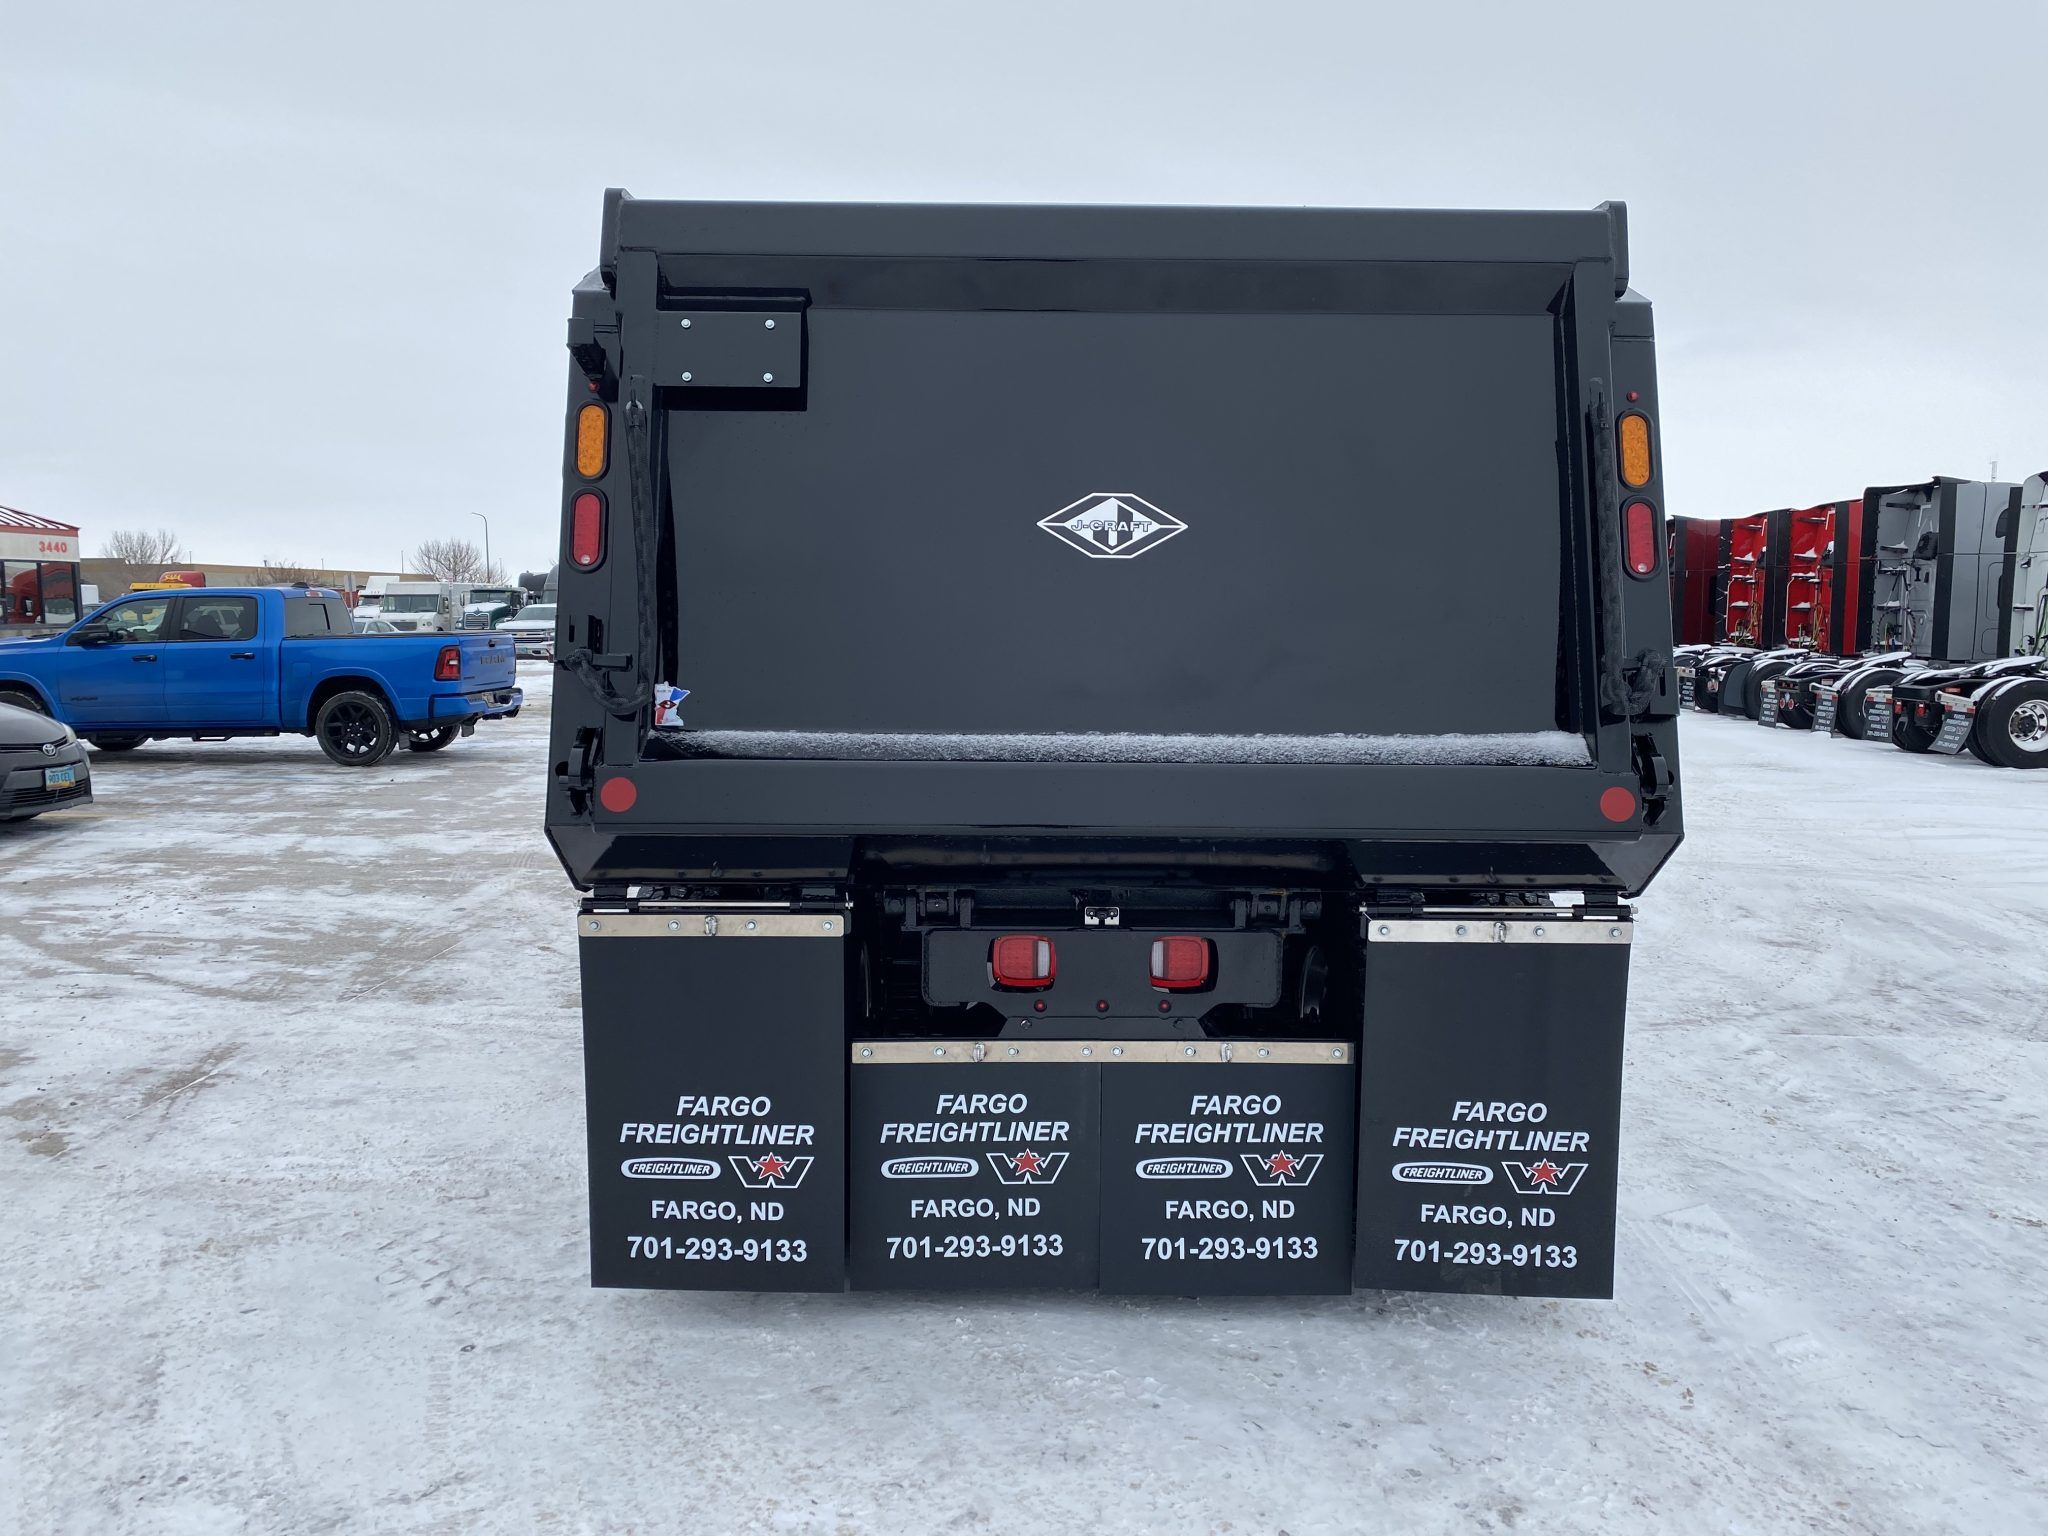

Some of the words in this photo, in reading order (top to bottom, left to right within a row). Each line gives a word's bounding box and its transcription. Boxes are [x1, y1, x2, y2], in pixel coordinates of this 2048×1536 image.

[1071, 520, 1152, 533] J-CRAFT
[38, 541, 68, 553] 3440
[676, 1095, 772, 1117] FARGO
[936, 1093, 1028, 1115] FARGO
[1190, 1094, 1282, 1116] FARGO
[1451, 1101, 1548, 1123] FARGO
[619, 1122, 815, 1146] FREIGHTLINER
[880, 1121, 1070, 1144] FREIGHTLINER
[1134, 1122, 1324, 1144] FREIGHTLINER
[1392, 1127, 1590, 1153] FREIGHTLINER
[631, 1162, 711, 1175] FREIGHTLINER
[891, 1161, 969, 1174] FREIGHTLINER
[1145, 1162, 1224, 1174] FREIGHTLINER
[1402, 1167, 1483, 1180] FREIGHTLINER
[651, 1199, 743, 1224] FARGO,
[750, 1201, 785, 1221] ND
[911, 1198, 1000, 1221] FARGO,
[1007, 1197, 1041, 1217] ND
[1165, 1199, 1255, 1223] FARGO,
[1262, 1199, 1295, 1219] ND
[1420, 1203, 1513, 1229] FARGO,
[1521, 1207, 1556, 1227] ND
[627, 1235, 808, 1263] 701-293-9133
[886, 1233, 1064, 1260] 701-293-9133
[1141, 1236, 1319, 1261] 701-293-9133
[1394, 1238, 1578, 1269] 701-293-9133
